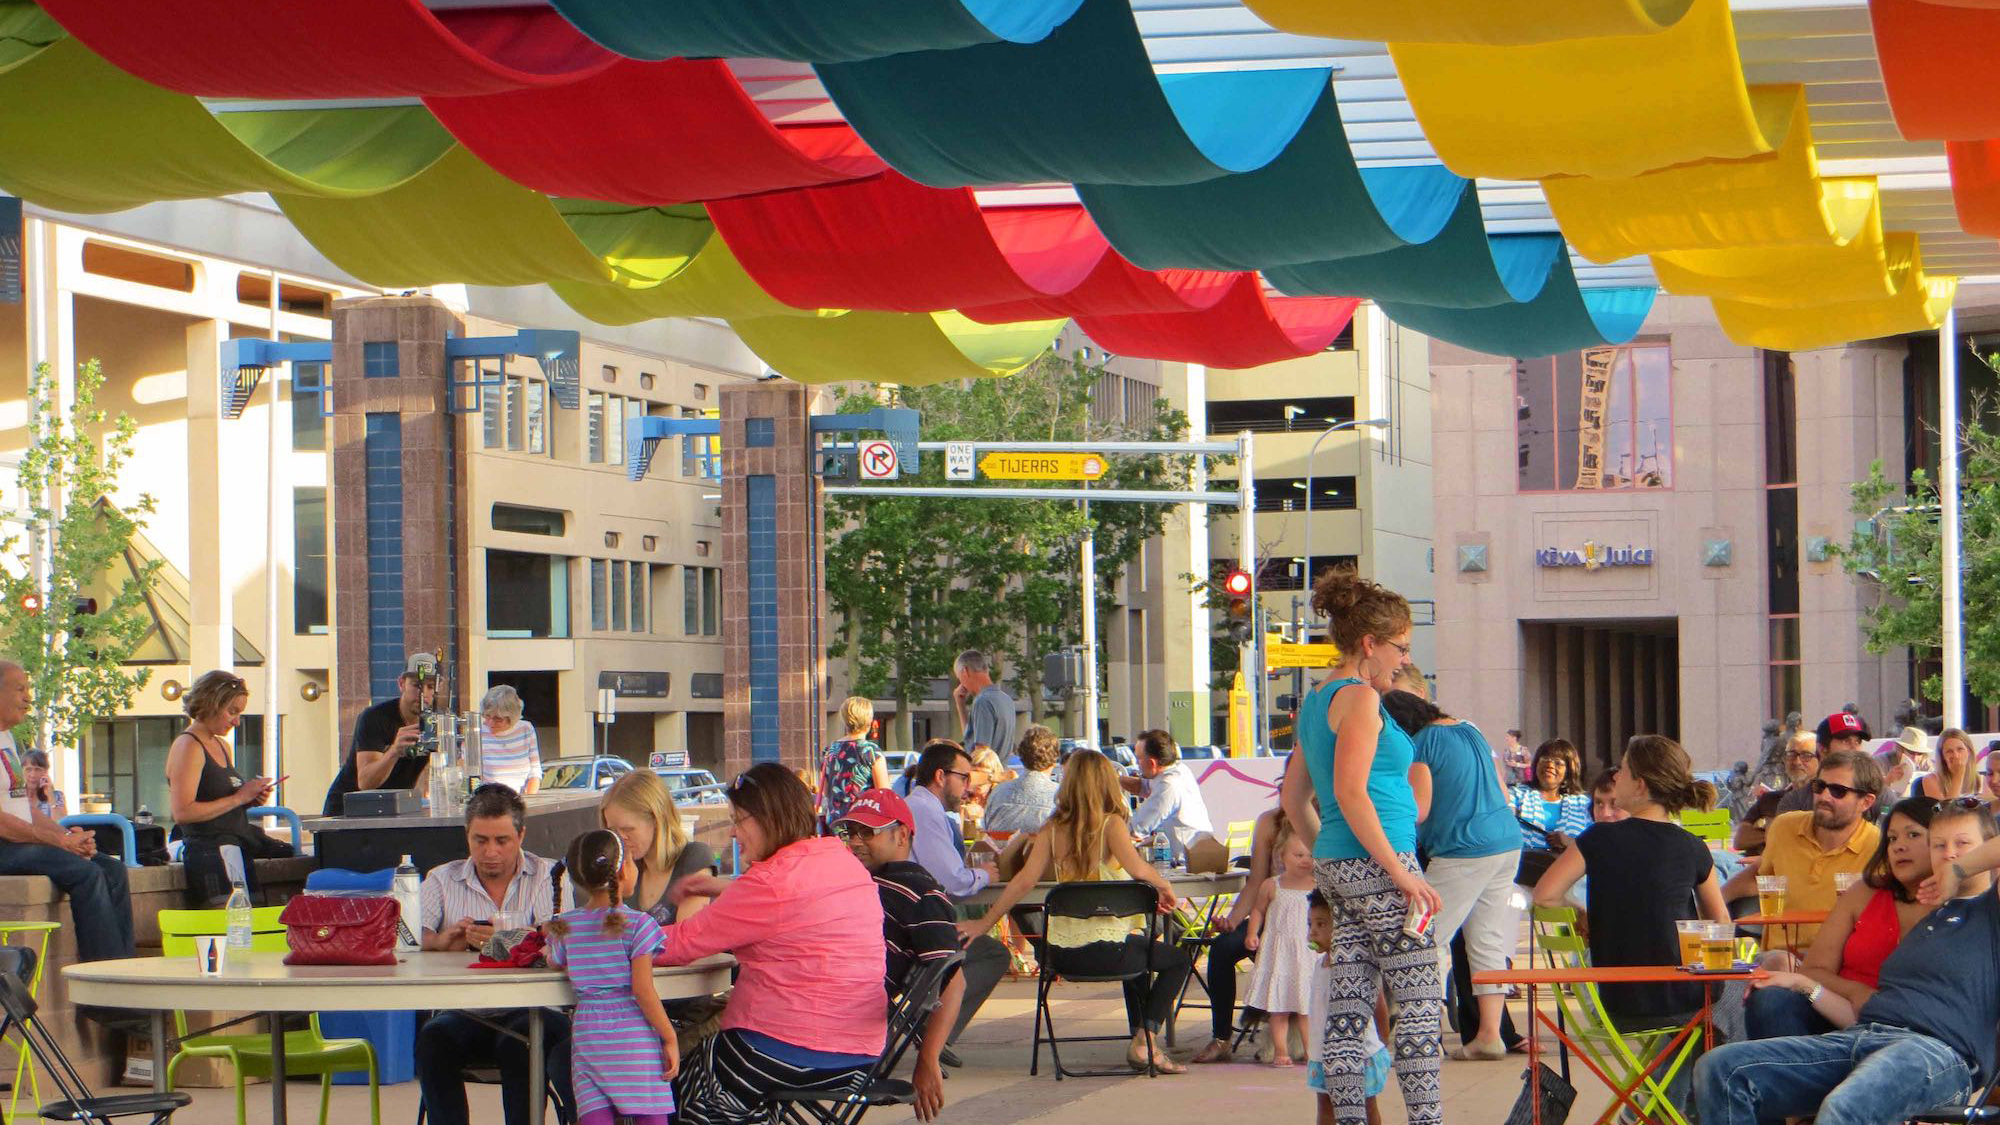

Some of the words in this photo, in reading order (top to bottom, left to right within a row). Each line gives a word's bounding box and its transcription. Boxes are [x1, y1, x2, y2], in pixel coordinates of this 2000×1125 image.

[950, 445, 971, 455] ONE
[949, 456, 971, 464] WAY
[999, 459, 1059, 474] TIJERAS
